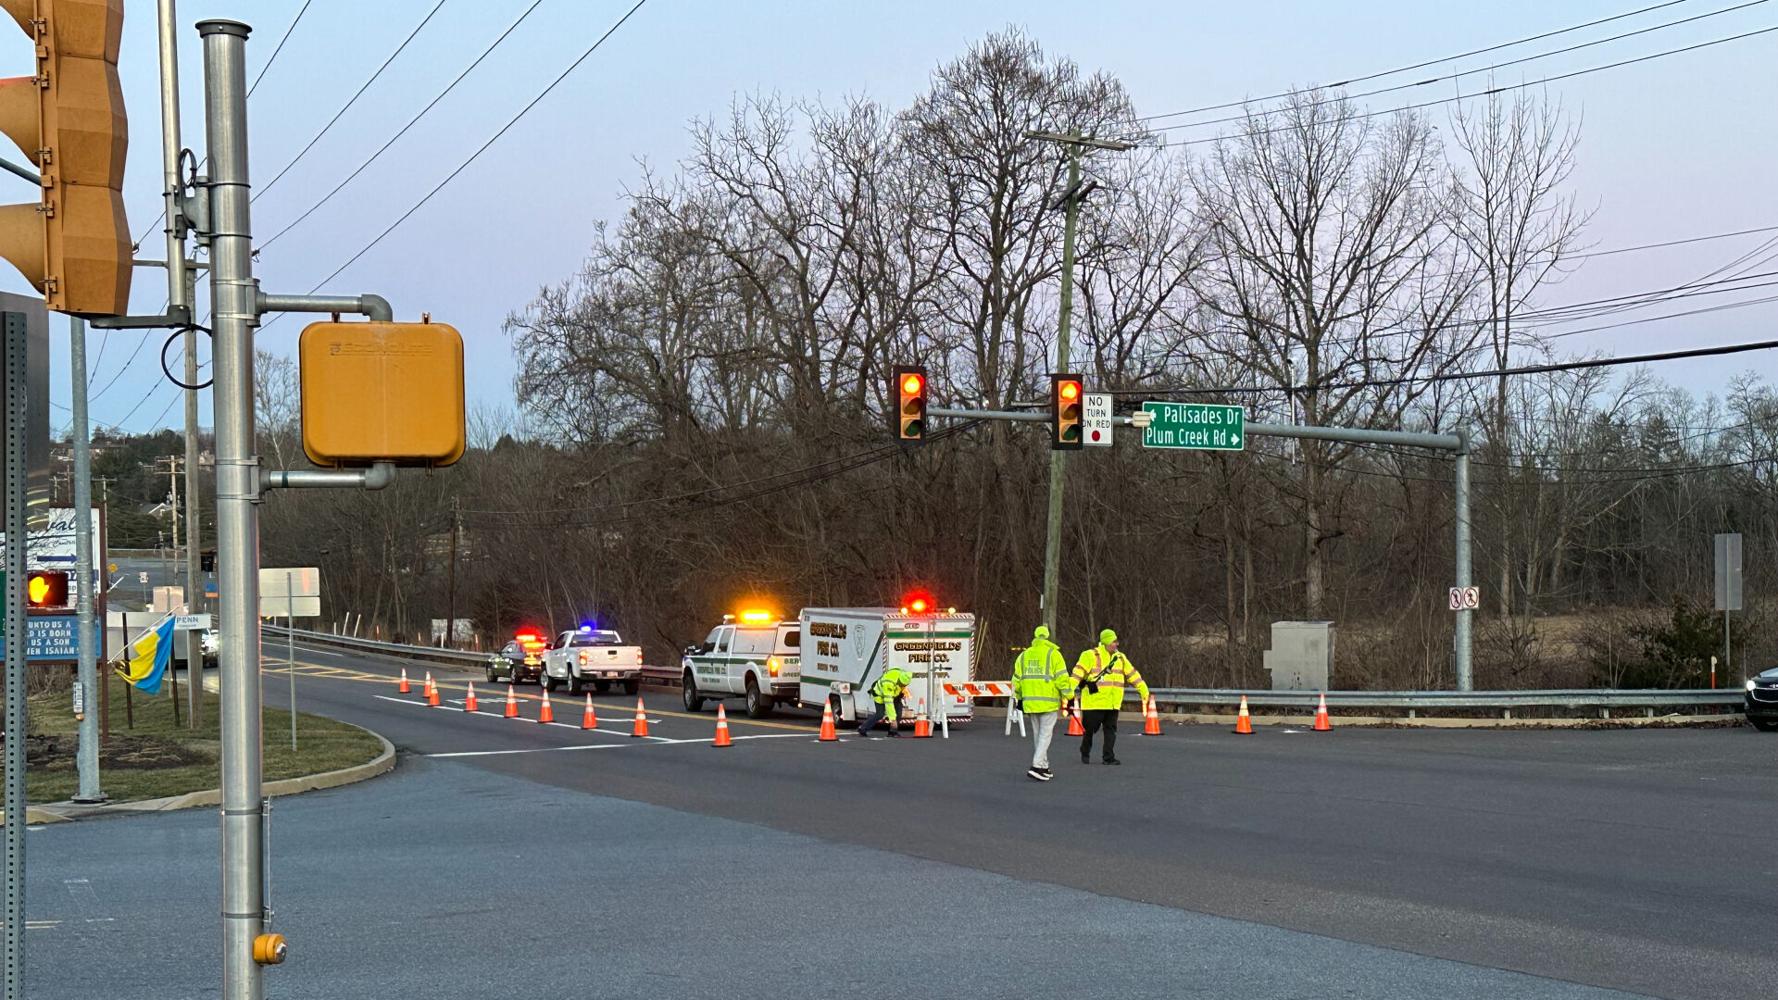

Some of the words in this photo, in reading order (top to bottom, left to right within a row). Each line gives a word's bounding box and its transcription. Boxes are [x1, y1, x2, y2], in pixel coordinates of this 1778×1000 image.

[1088, 397, 1103, 407] NO
[1086, 409, 1106, 418] TURN
[1164, 406, 1222, 424] Palisades
[1226, 410, 1240, 424] Dr
[1096, 420, 1110, 428] RED
[1146, 427, 1174, 444] Plum
[1178, 428, 1209, 445] Creek
[1214, 430, 1226, 446] Rd
